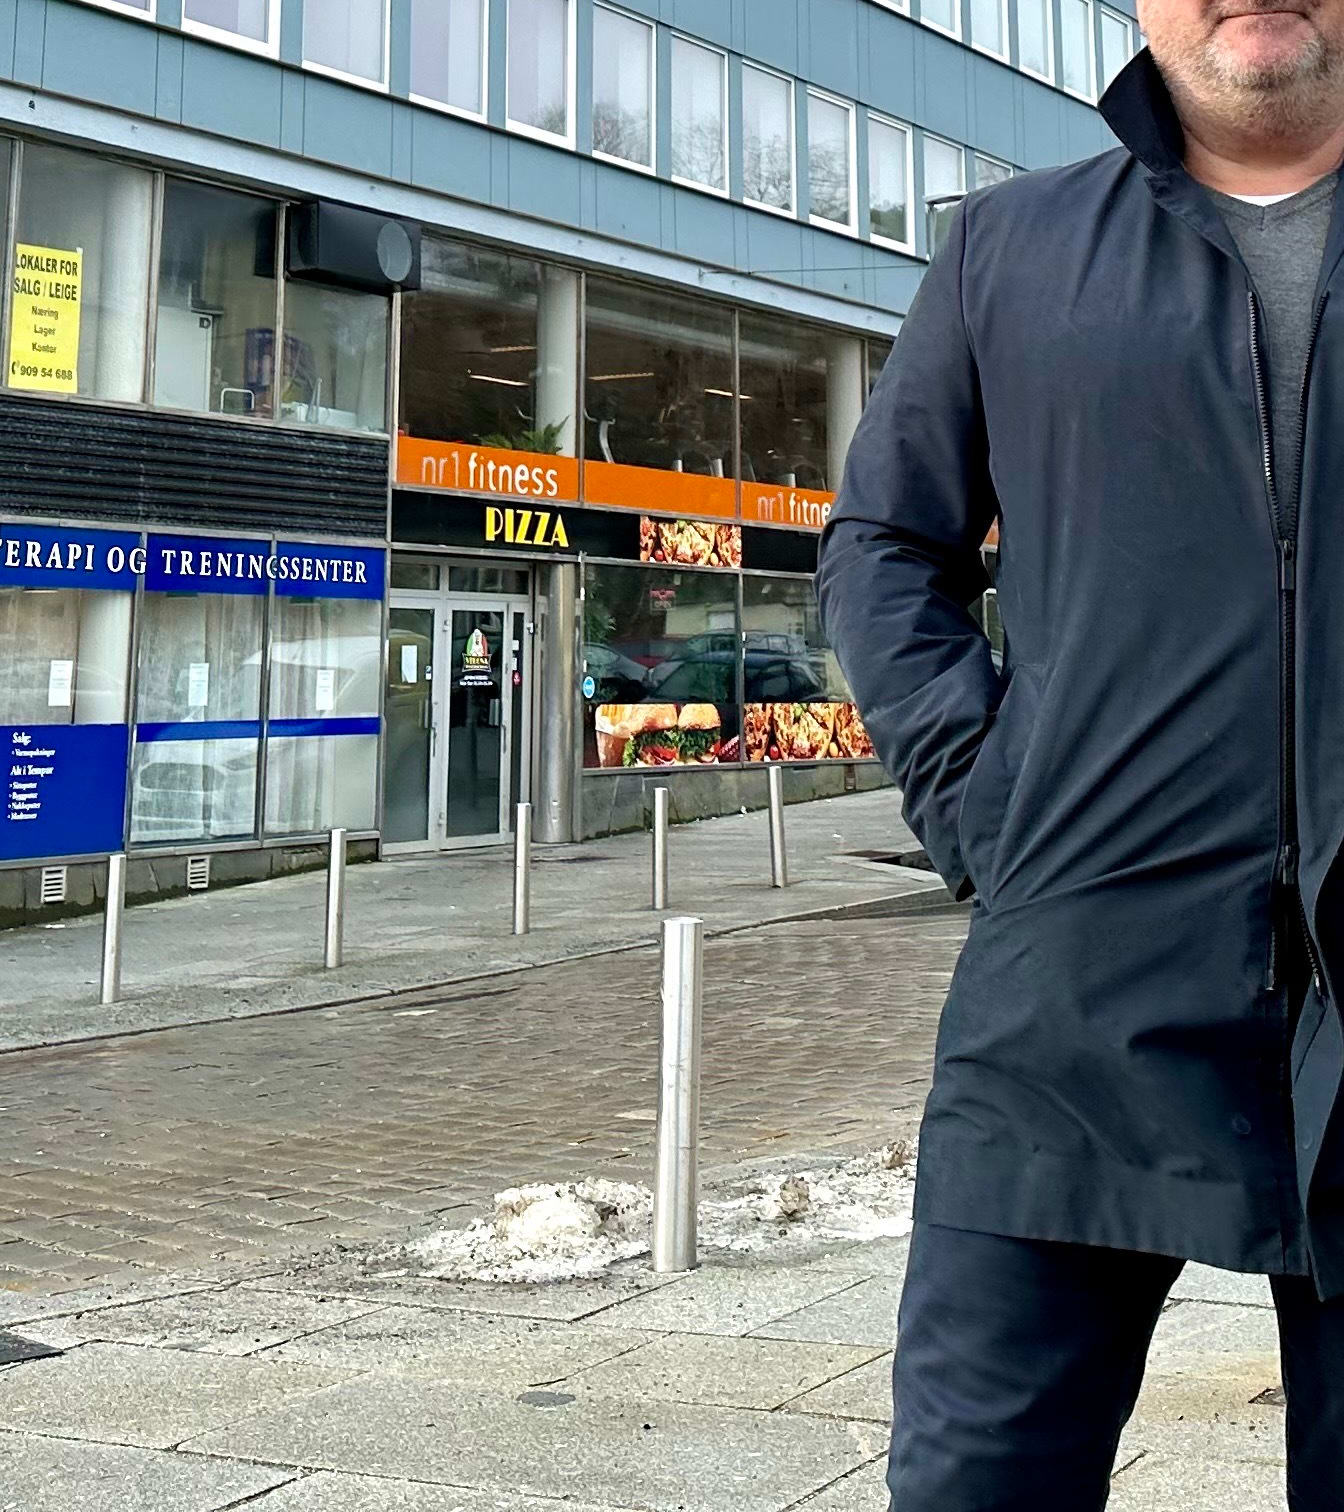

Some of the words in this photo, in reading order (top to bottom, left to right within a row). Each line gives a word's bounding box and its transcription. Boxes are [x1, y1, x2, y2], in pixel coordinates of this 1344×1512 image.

[60, 260, 77, 276] FOR
[14, 277, 41, 296] SALG
[49, 282, 77, 301] LEIGE
[34, 324, 56, 337] Lager
[20, 366, 38, 377] 909
[41, 368, 53, 378] 54
[422, 451, 459, 487] nr1
[468, 452, 558, 497] fitness
[789, 492, 832, 526] fitne
[485, 506, 569, 548] PIZZA
[106, 546, 147, 574] OG
[162, 550, 367, 583] TRENINGSSENTER
